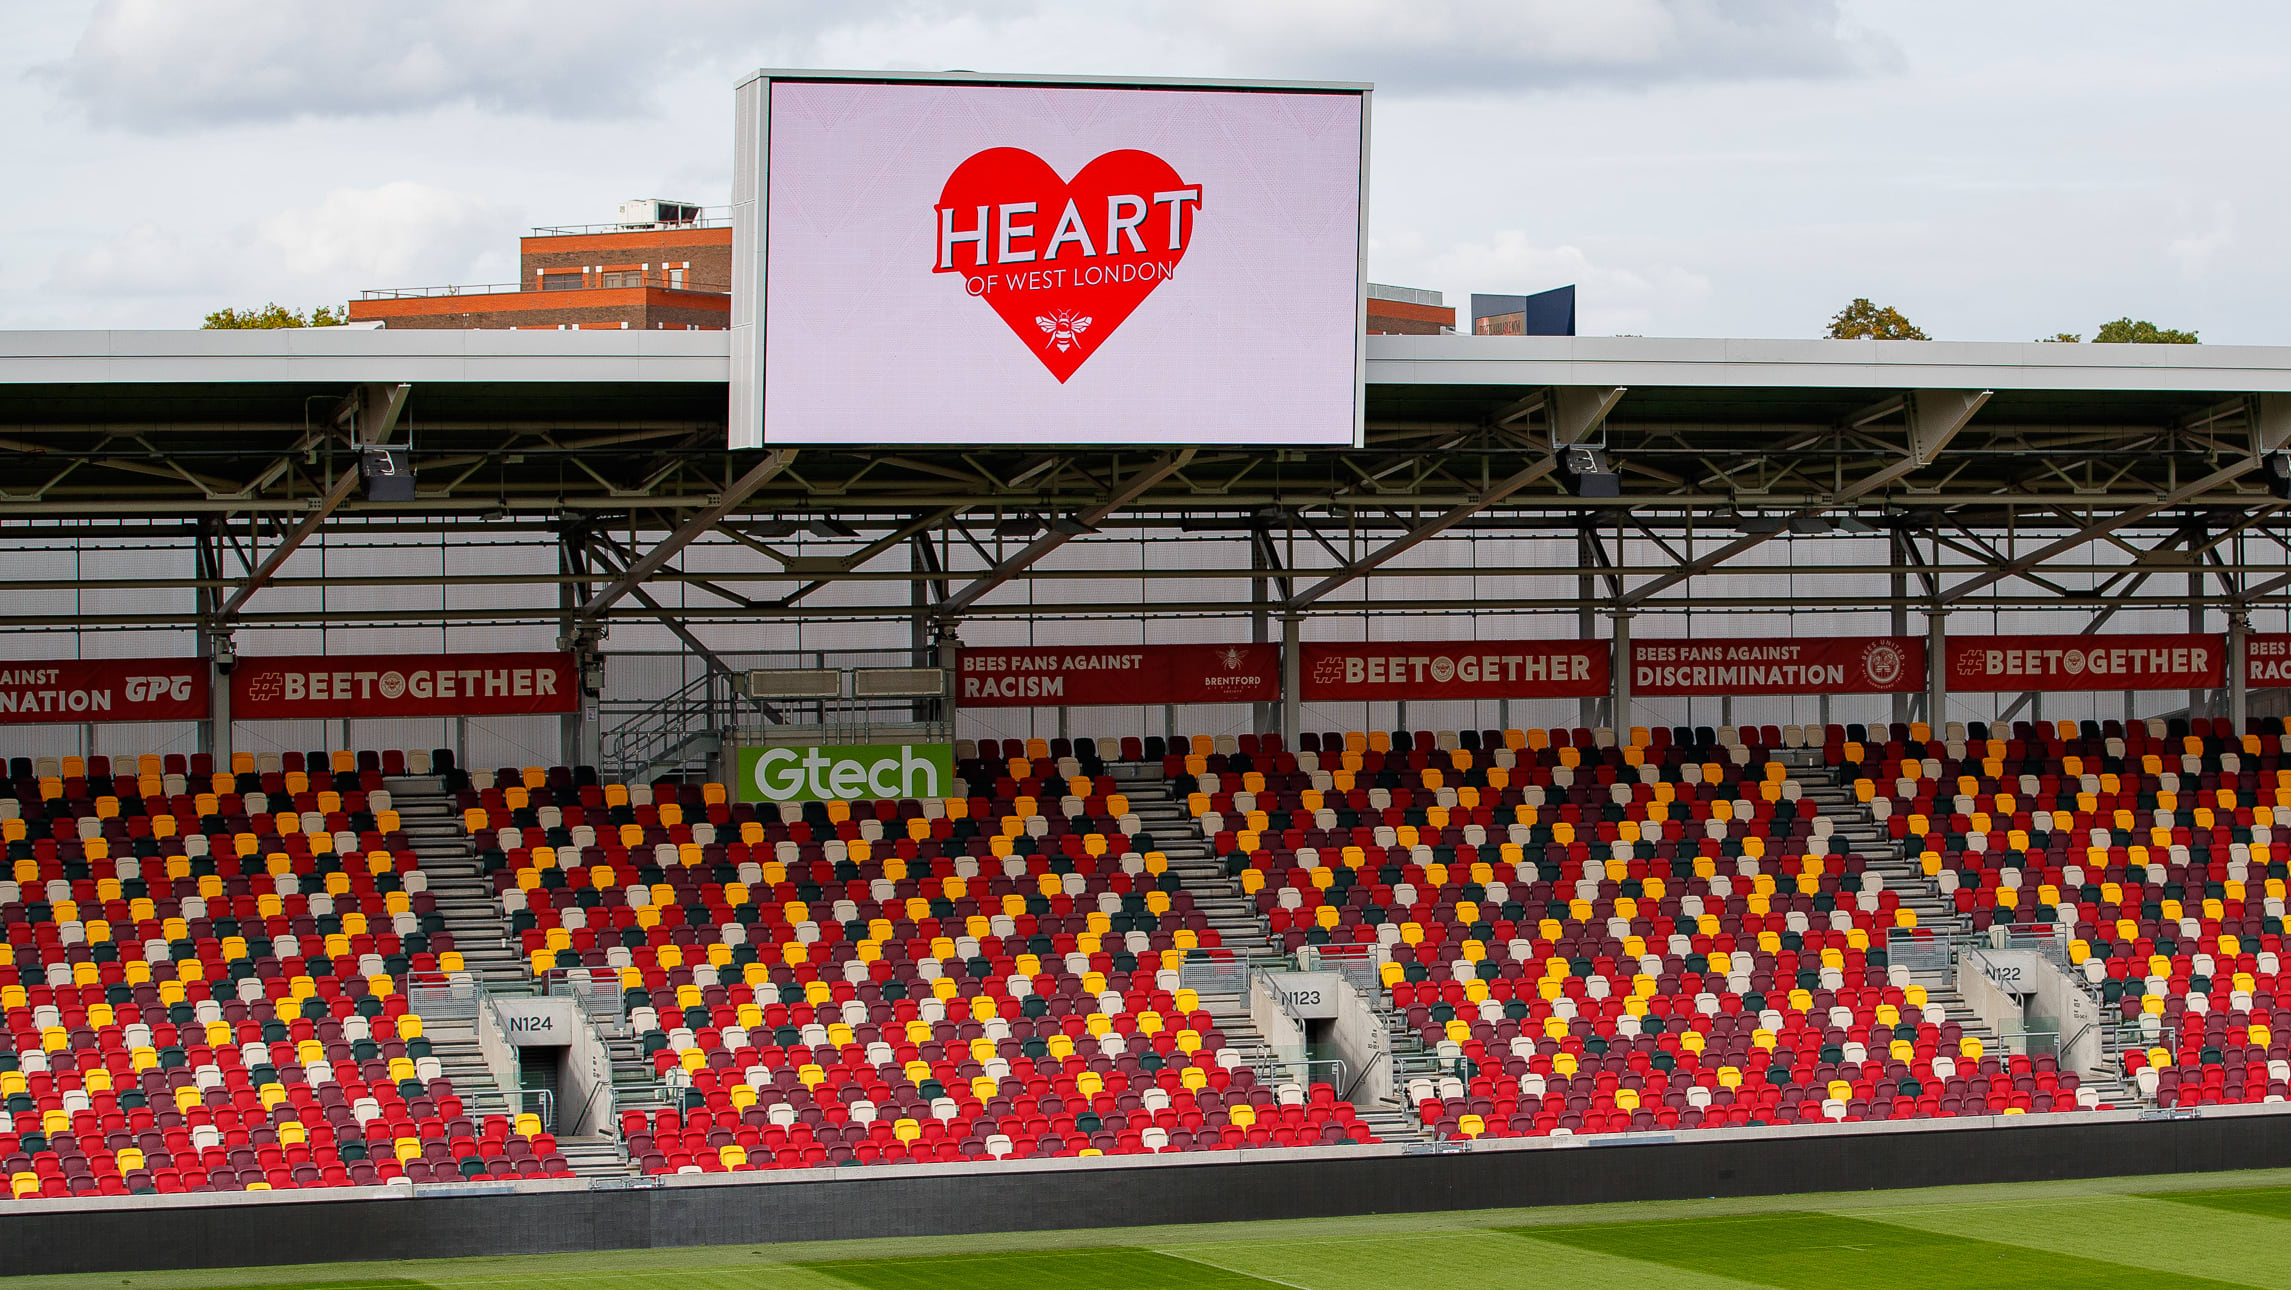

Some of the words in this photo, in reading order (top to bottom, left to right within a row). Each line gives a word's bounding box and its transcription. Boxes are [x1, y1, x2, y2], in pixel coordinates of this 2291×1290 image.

[940, 189, 1199, 268] HEART
[967, 275, 998, 295] OF
[1006, 269, 1066, 291] WEST
[1074, 260, 1173, 287] LONDON
[1636, 647, 1676, 661] BEES
[1680, 646, 1723, 661] FANS
[1726, 646, 1801, 660] AGAINST
[2250, 641, 2286, 656] BEES
[963, 657, 1007, 672] BEES
[1011, 656, 1058, 671] FANS
[1062, 654, 1143, 670] AGAINST
[2250, 660, 2291, 680] RAC
[1205, 676, 1261, 686] BRENTFORD
[1637, 664, 1844, 686] DISCRIMINATION
[125, 675, 192, 702] GPG
[964, 676, 1064, 698] RACISM
[754, 745, 938, 801] Gtech
[1986, 967, 2021, 981] N122
[1281, 990, 1321, 1005] N123
[510, 1016, 553, 1032] N124
